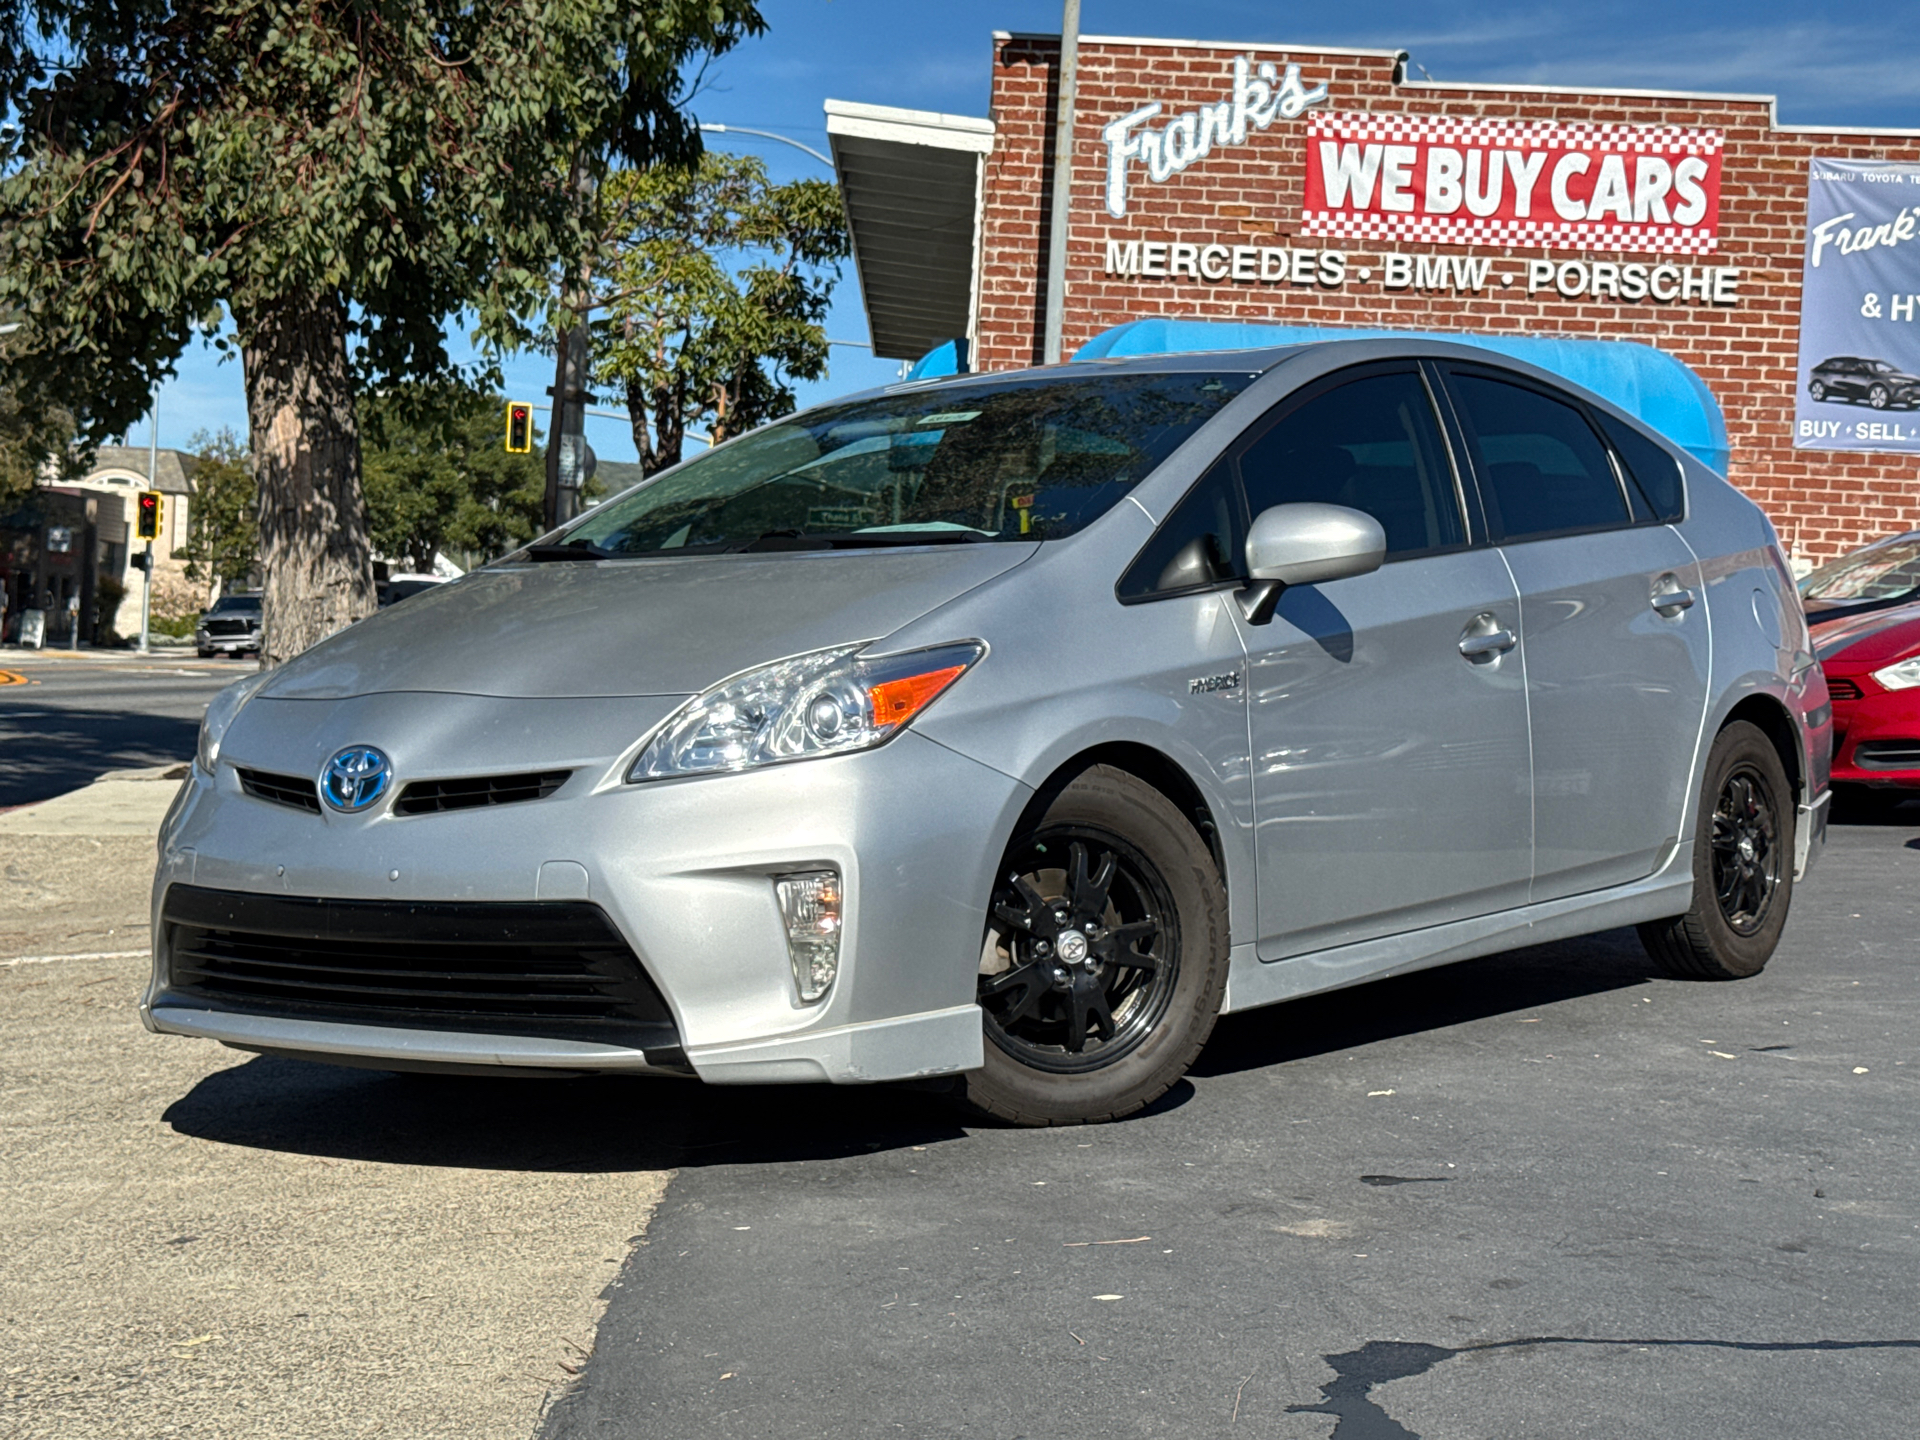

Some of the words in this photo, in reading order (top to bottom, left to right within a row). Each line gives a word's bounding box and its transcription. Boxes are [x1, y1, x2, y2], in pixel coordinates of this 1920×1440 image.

[1103, 55, 1329, 219] Frank's
[1319, 141, 1417, 213] WE
[1424, 146, 1548, 218] BUY
[1550, 152, 1709, 226] CARS
[1812, 171, 1855, 182] SUBARU
[1862, 172, 1903, 183] TOYOTA
[1811, 206, 1920, 268] Frank'
[1105, 240, 1346, 286] MERCEDES
[1384, 252, 1491, 291] BMW
[1528, 259, 1740, 303] PORSCHE
[1861, 292, 1882, 319] &
[1800, 419, 1841, 438] BUY
[1855, 422, 1907, 441] SELL
[1190, 865, 1217, 1032] Advantage
